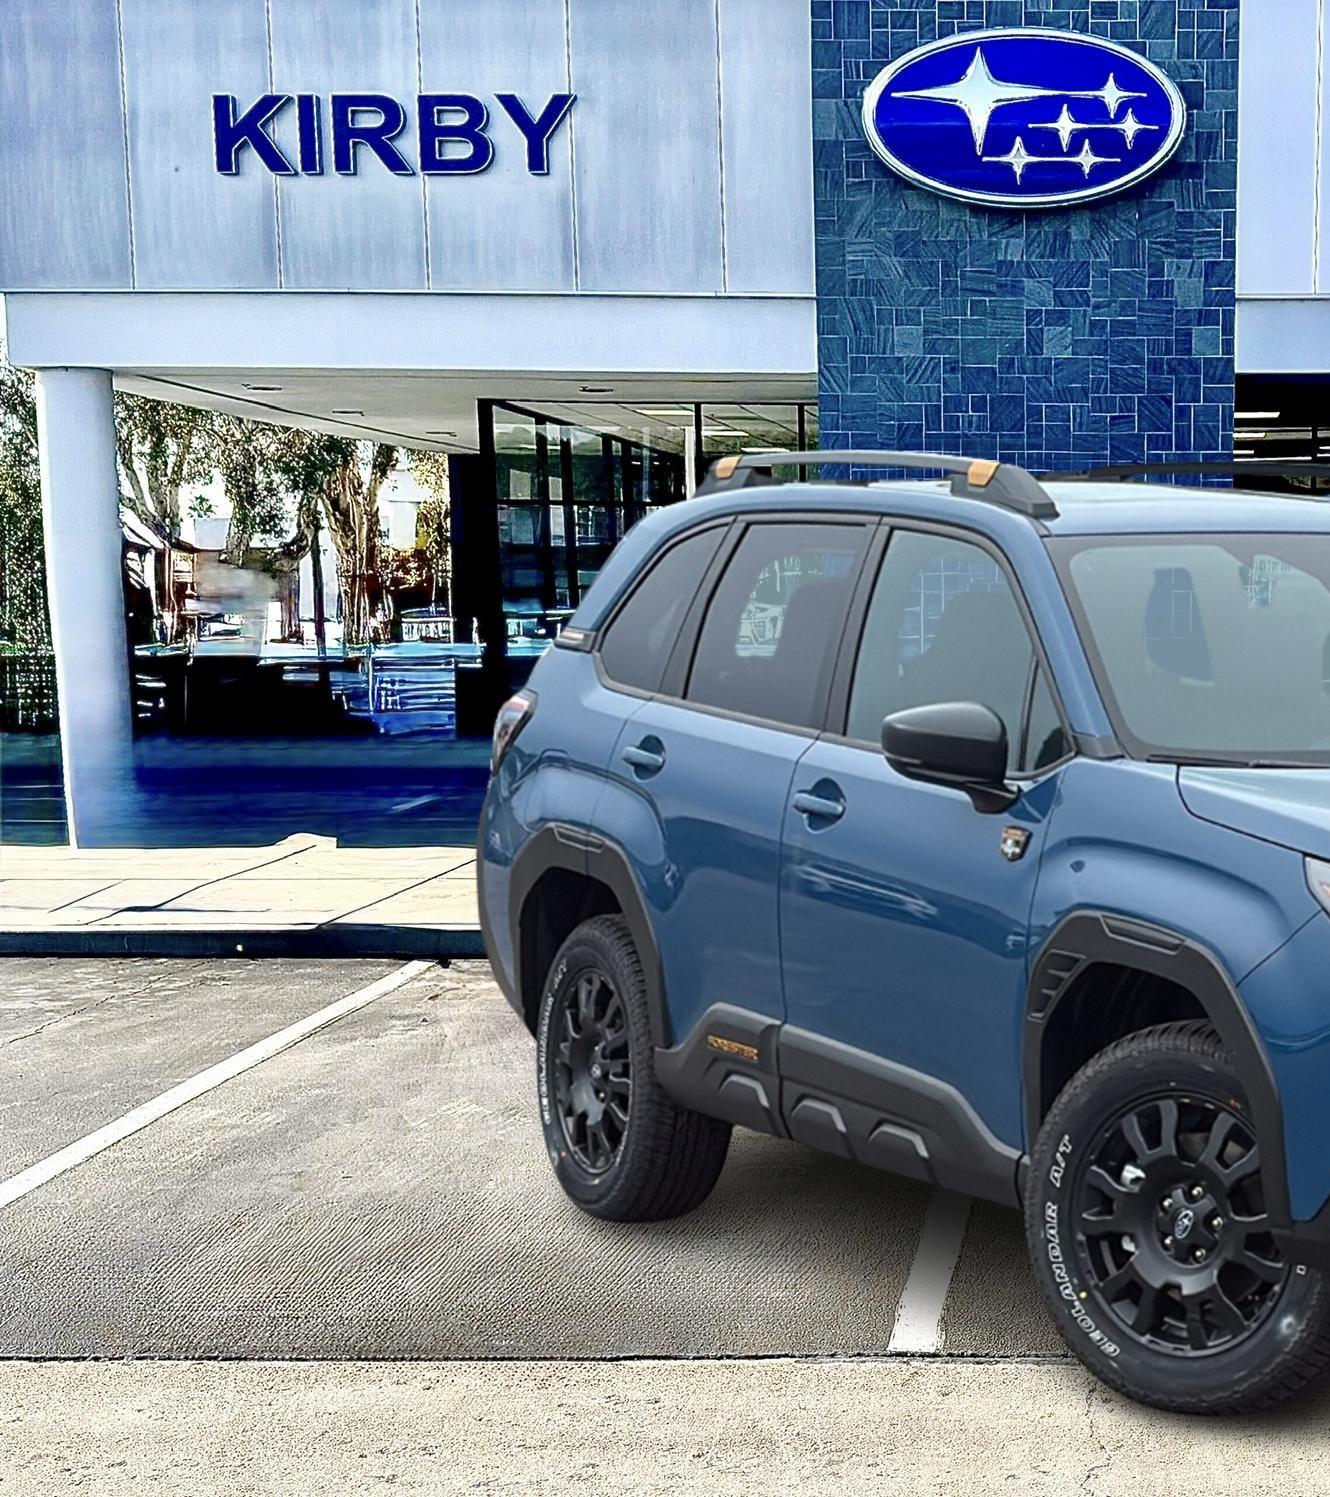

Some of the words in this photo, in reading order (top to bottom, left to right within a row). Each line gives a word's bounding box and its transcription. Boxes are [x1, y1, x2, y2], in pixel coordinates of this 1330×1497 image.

[211, 92, 577, 176] KIRBY
[1049, 1134, 1073, 1188] A/T
[1045, 1201, 1121, 1358] GEOLANDAR
